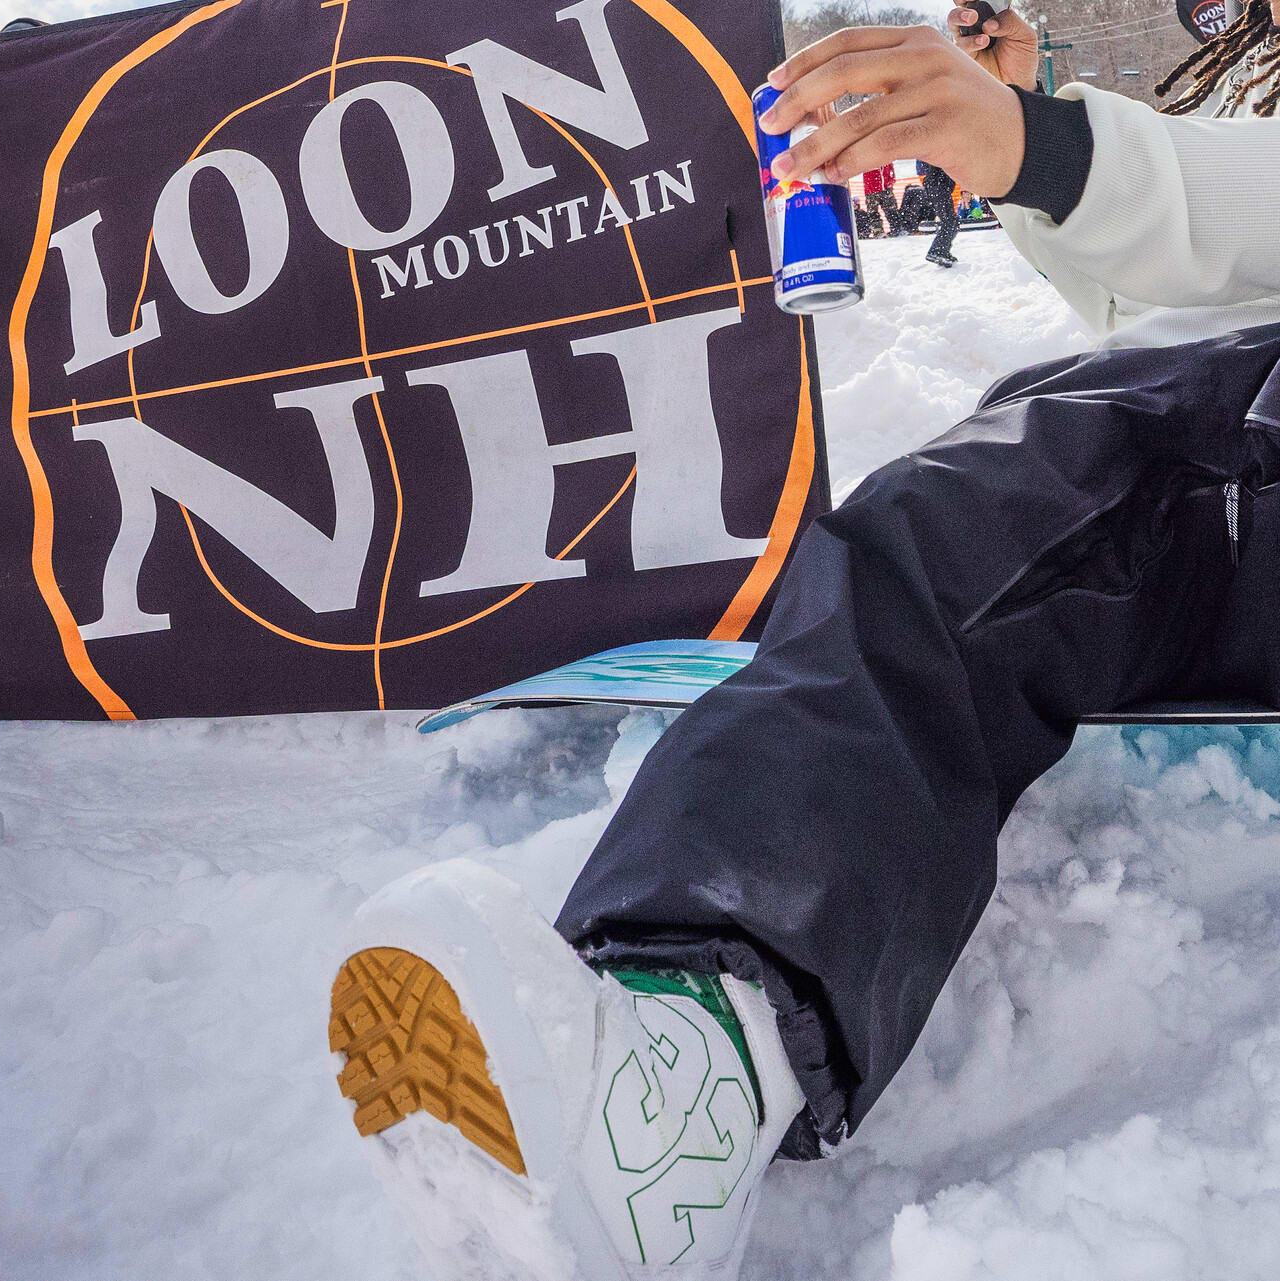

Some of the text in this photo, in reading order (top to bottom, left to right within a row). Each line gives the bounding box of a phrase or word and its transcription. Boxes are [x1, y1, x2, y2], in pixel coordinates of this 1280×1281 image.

[1193, 3, 1225, 26] LOON
[370, 159, 697, 301] MOUNTAIN
[795, 196, 833, 209] DRINK
[72, 306, 771, 641] NH
